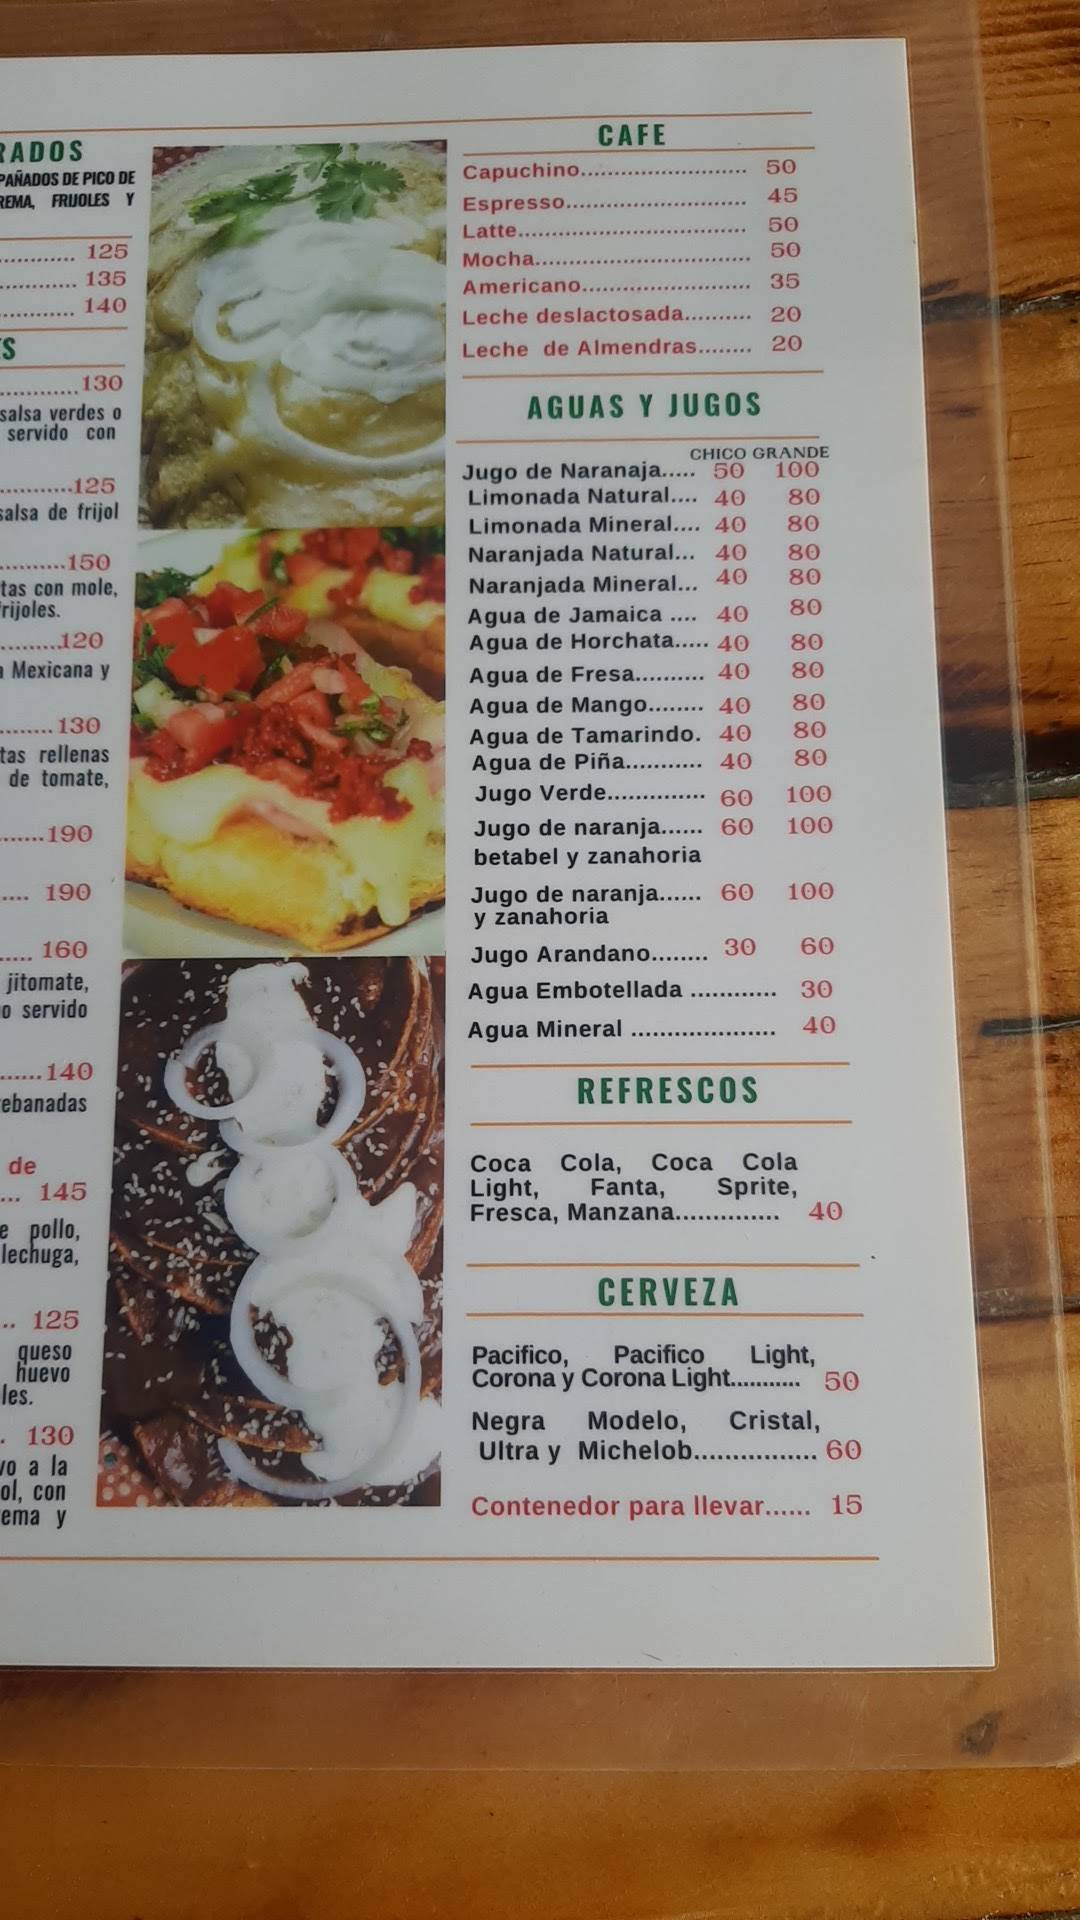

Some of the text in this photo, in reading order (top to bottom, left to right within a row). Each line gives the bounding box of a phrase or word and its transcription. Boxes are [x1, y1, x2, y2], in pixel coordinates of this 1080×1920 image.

[599, 124, 665, 146] CAFE
[767, 159, 796, 174] 50
[63, 171, 135, 186] DE PICO DE
[126, 193, 134, 206] Y
[768, 188, 797, 203] 45
[769, 217, 798, 232] 50
[89, 244, 128, 259] 125
[771, 242, 800, 258] 50
[88, 271, 126, 286] 135
[771, 273, 799, 289] 35
[86, 298, 126, 313] 140
[463, 306, 801, 325] Leche 20
[463, 342, 528, 358] Leche
[544, 341, 568, 356] de
[773, 335, 802, 351] 20
[50, 404, 121, 421] verdes o
[528, 392, 760, 419] AGUAS Y JUGOS
[8, 423, 115, 441] servido con
[690, 446, 829, 460] CHICO GRANDE
[463, 465, 517, 484] Jugo
[526, 463, 552, 479] de
[714, 463, 744, 479] 50
[777, 461, 819, 478] 100
[469, 488, 579, 505] Limonada
[715, 490, 745, 506] 40
[789, 488, 820, 505] 80
[49, 502, 118, 522] de frijol
[470, 517, 581, 534] Limonada
[715, 517, 746, 533] 40
[788, 515, 819, 532] 80
[469, 545, 584, 566] Naranjada
[716, 544, 747, 560] 40
[789, 544, 820, 560] 80
[35, 578, 117, 597] con mole,
[470, 576, 585, 597] Naranjada
[716, 568, 747, 584] 40
[790, 568, 821, 585] 80
[468, 599, 822, 628] Agua de Jamaica 40 80
[470, 635, 528, 654] Agua
[536, 633, 562, 649] de
[717, 635, 749, 652] 40
[791, 634, 823, 650] 80
[12, 661, 109, 680] Mexicana y
[470, 662, 824, 687] Agua de 40 80
[470, 694, 825, 718] Agua de 40 80
[60, 717, 100, 734] 130
[470, 729, 528, 749] Agua
[537, 727, 563, 744] de
[720, 725, 751, 742] 40
[794, 721, 826, 738] 80
[40, 745, 109, 763] rellenas
[472, 749, 827, 775] Agua de 40 80
[9, 769, 108, 788] de tomate,
[475, 785, 831, 807] Jugo 60 100
[474, 821, 530, 840] Jugo
[539, 819, 565, 836] de
[721, 818, 753, 835] 60
[789, 816, 833, 834] 100
[475, 846, 701, 869] betabel y zanahoria
[47, 884, 91, 901] 190
[471, 887, 527, 907] Jugo
[537, 885, 563, 902] de
[721, 884, 753, 901] 60
[789, 882, 834, 900] 100
[474, 906, 609, 930] y zanahoria
[471, 937, 834, 967] Jugo 30 60
[6, 973, 88, 994] jitomate,
[468, 980, 832, 1004] Agua Embotellada 30
[22, 999, 87, 1019] servido
[468, 1016, 835, 1043] Agua Mineral 40
[578, 1077, 757, 1104] REFRESCOS
[9, 1157, 36, 1174] de
[471, 1152, 798, 1174] Coca Cola, Coca Cola
[41, 1182, 86, 1201] 145
[471, 1177, 796, 1201] Light, Fanta, Sprite,
[471, 1202, 842, 1224] Fresca, 40
[30, 1218, 79, 1242] pollo,
[598, 1278, 738, 1306] CERVEZA
[34, 1311, 78, 1329] 125
[473, 1344, 814, 1369] Pacifico, Pacifico Light,
[473, 1368, 859, 1392] Corona y Corona 50
[473, 1410, 819, 1435] Negra Modelo, Cristal,
[29, 1426, 74, 1445] 130
[480, 1440, 861, 1465] Ultra y 60
[472, 1495, 620, 1516] Contenedor
[630, 1500, 684, 1520] para
[833, 1495, 862, 1514] 15
